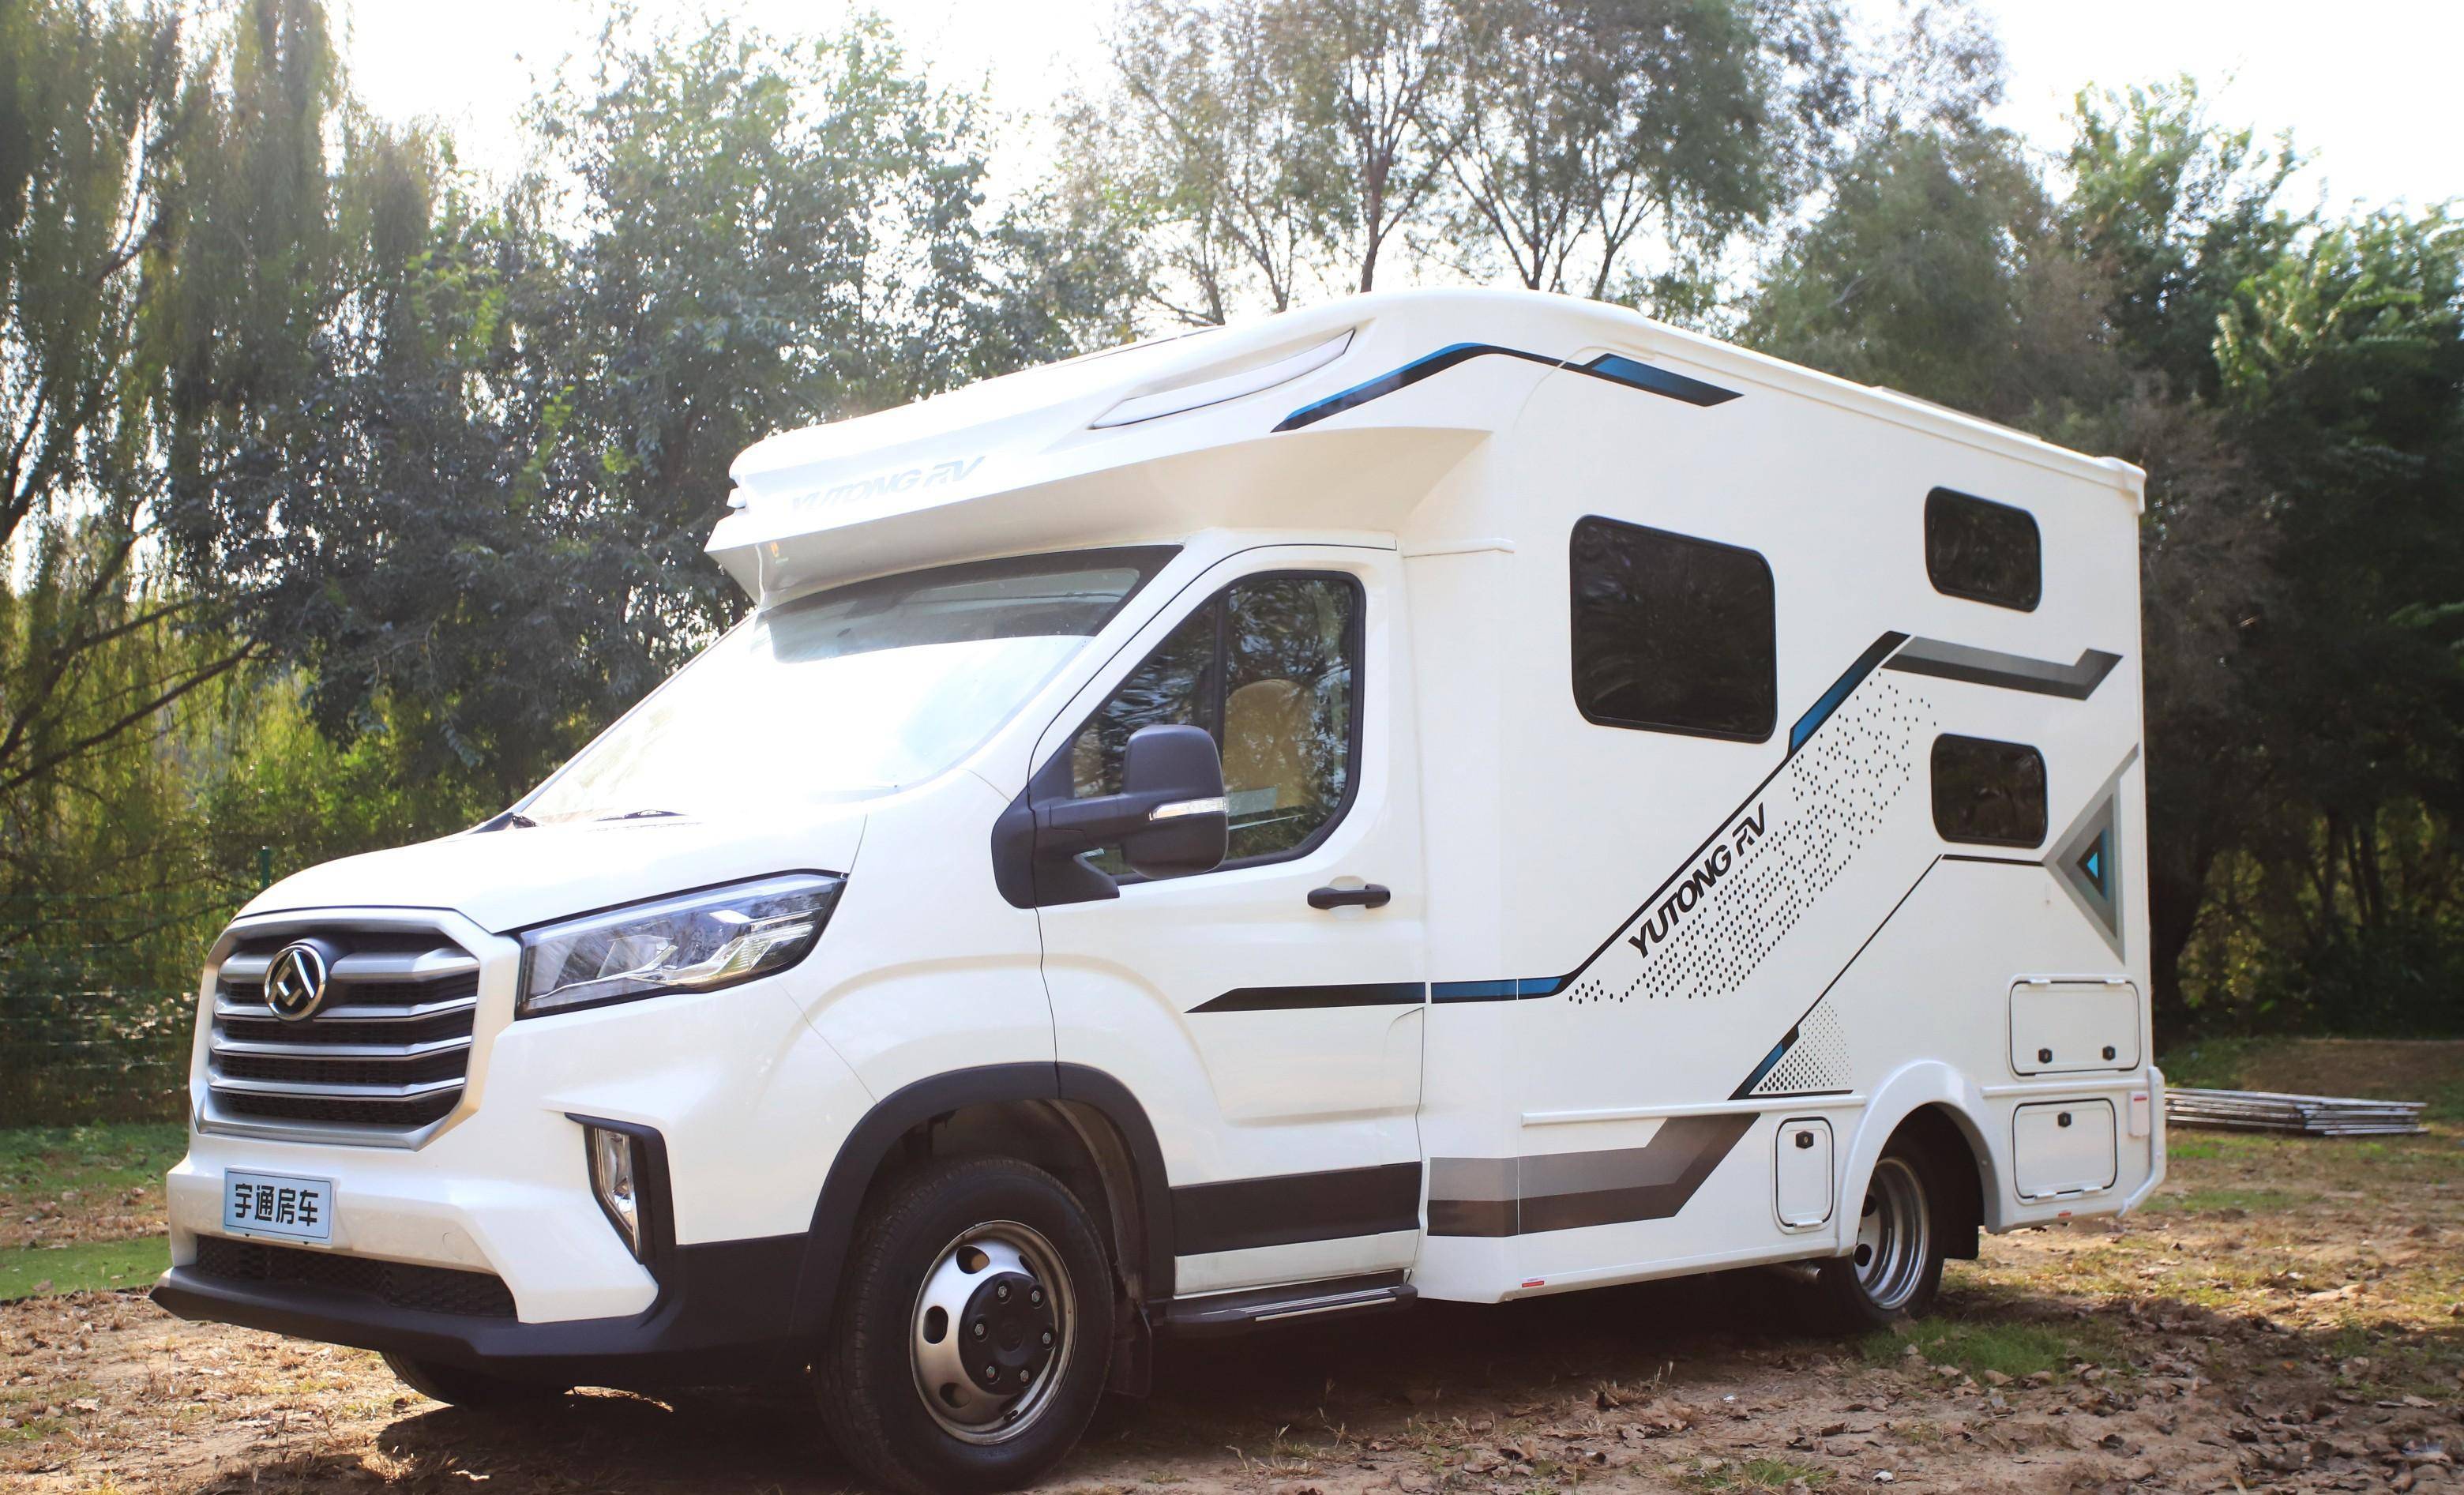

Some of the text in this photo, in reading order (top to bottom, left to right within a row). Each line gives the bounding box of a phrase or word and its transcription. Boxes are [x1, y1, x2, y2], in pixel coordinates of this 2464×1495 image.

[792, 456, 986, 509] YUTONG RV
[1628, 802, 1765, 959] YUTONG RV
[235, 1183, 318, 1226] 宇通房车
